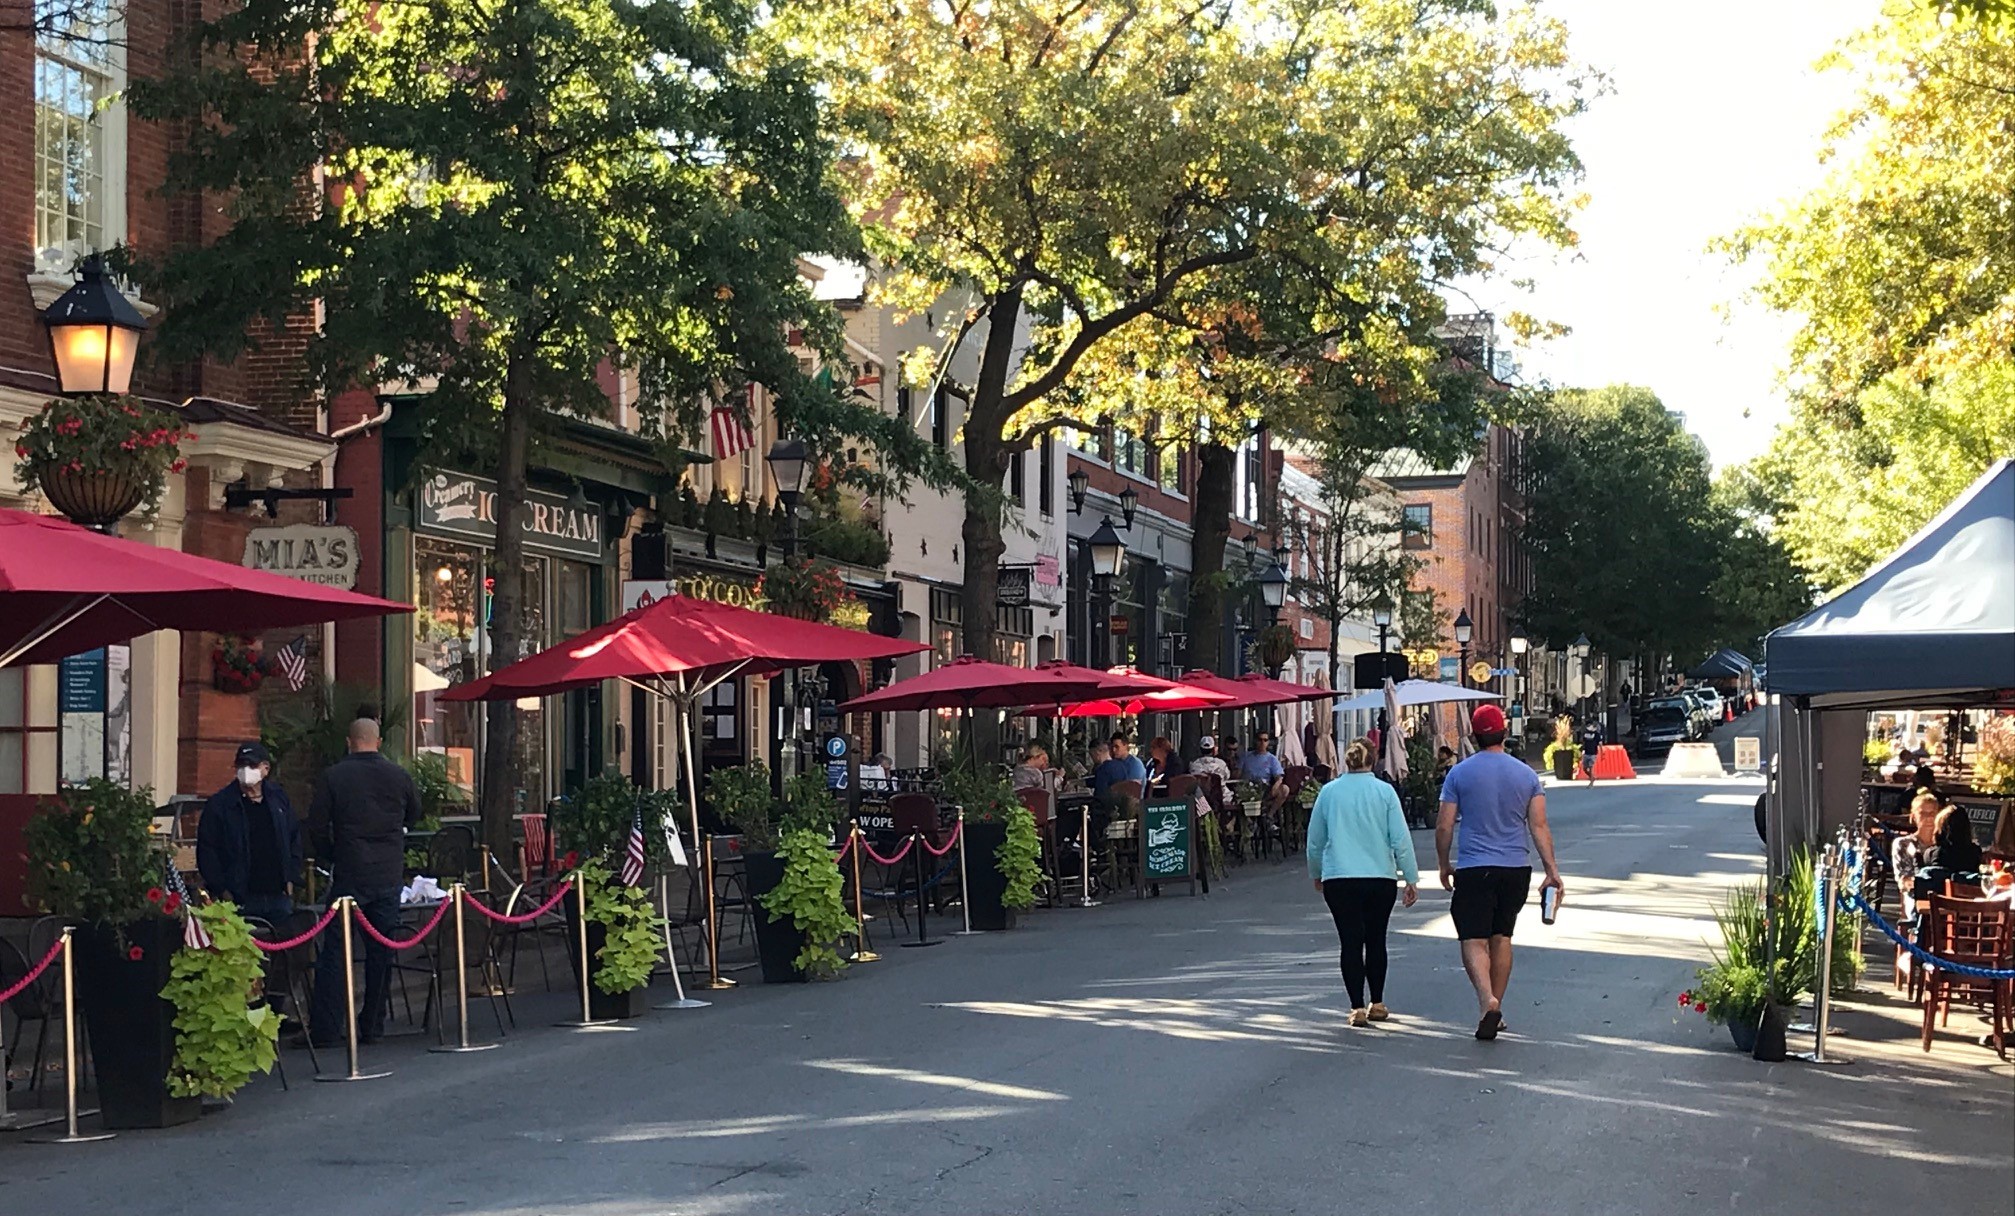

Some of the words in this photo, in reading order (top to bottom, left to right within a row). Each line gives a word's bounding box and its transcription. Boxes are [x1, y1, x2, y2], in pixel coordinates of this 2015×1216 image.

[424, 479, 476, 508] Creamery
[478, 490, 498, 524] IC
[521, 499, 599, 543] CREAM
[252, 537, 349, 569] MIA'S
[859, 816, 871, 827] W
[872, 817, 894, 828] OPE
